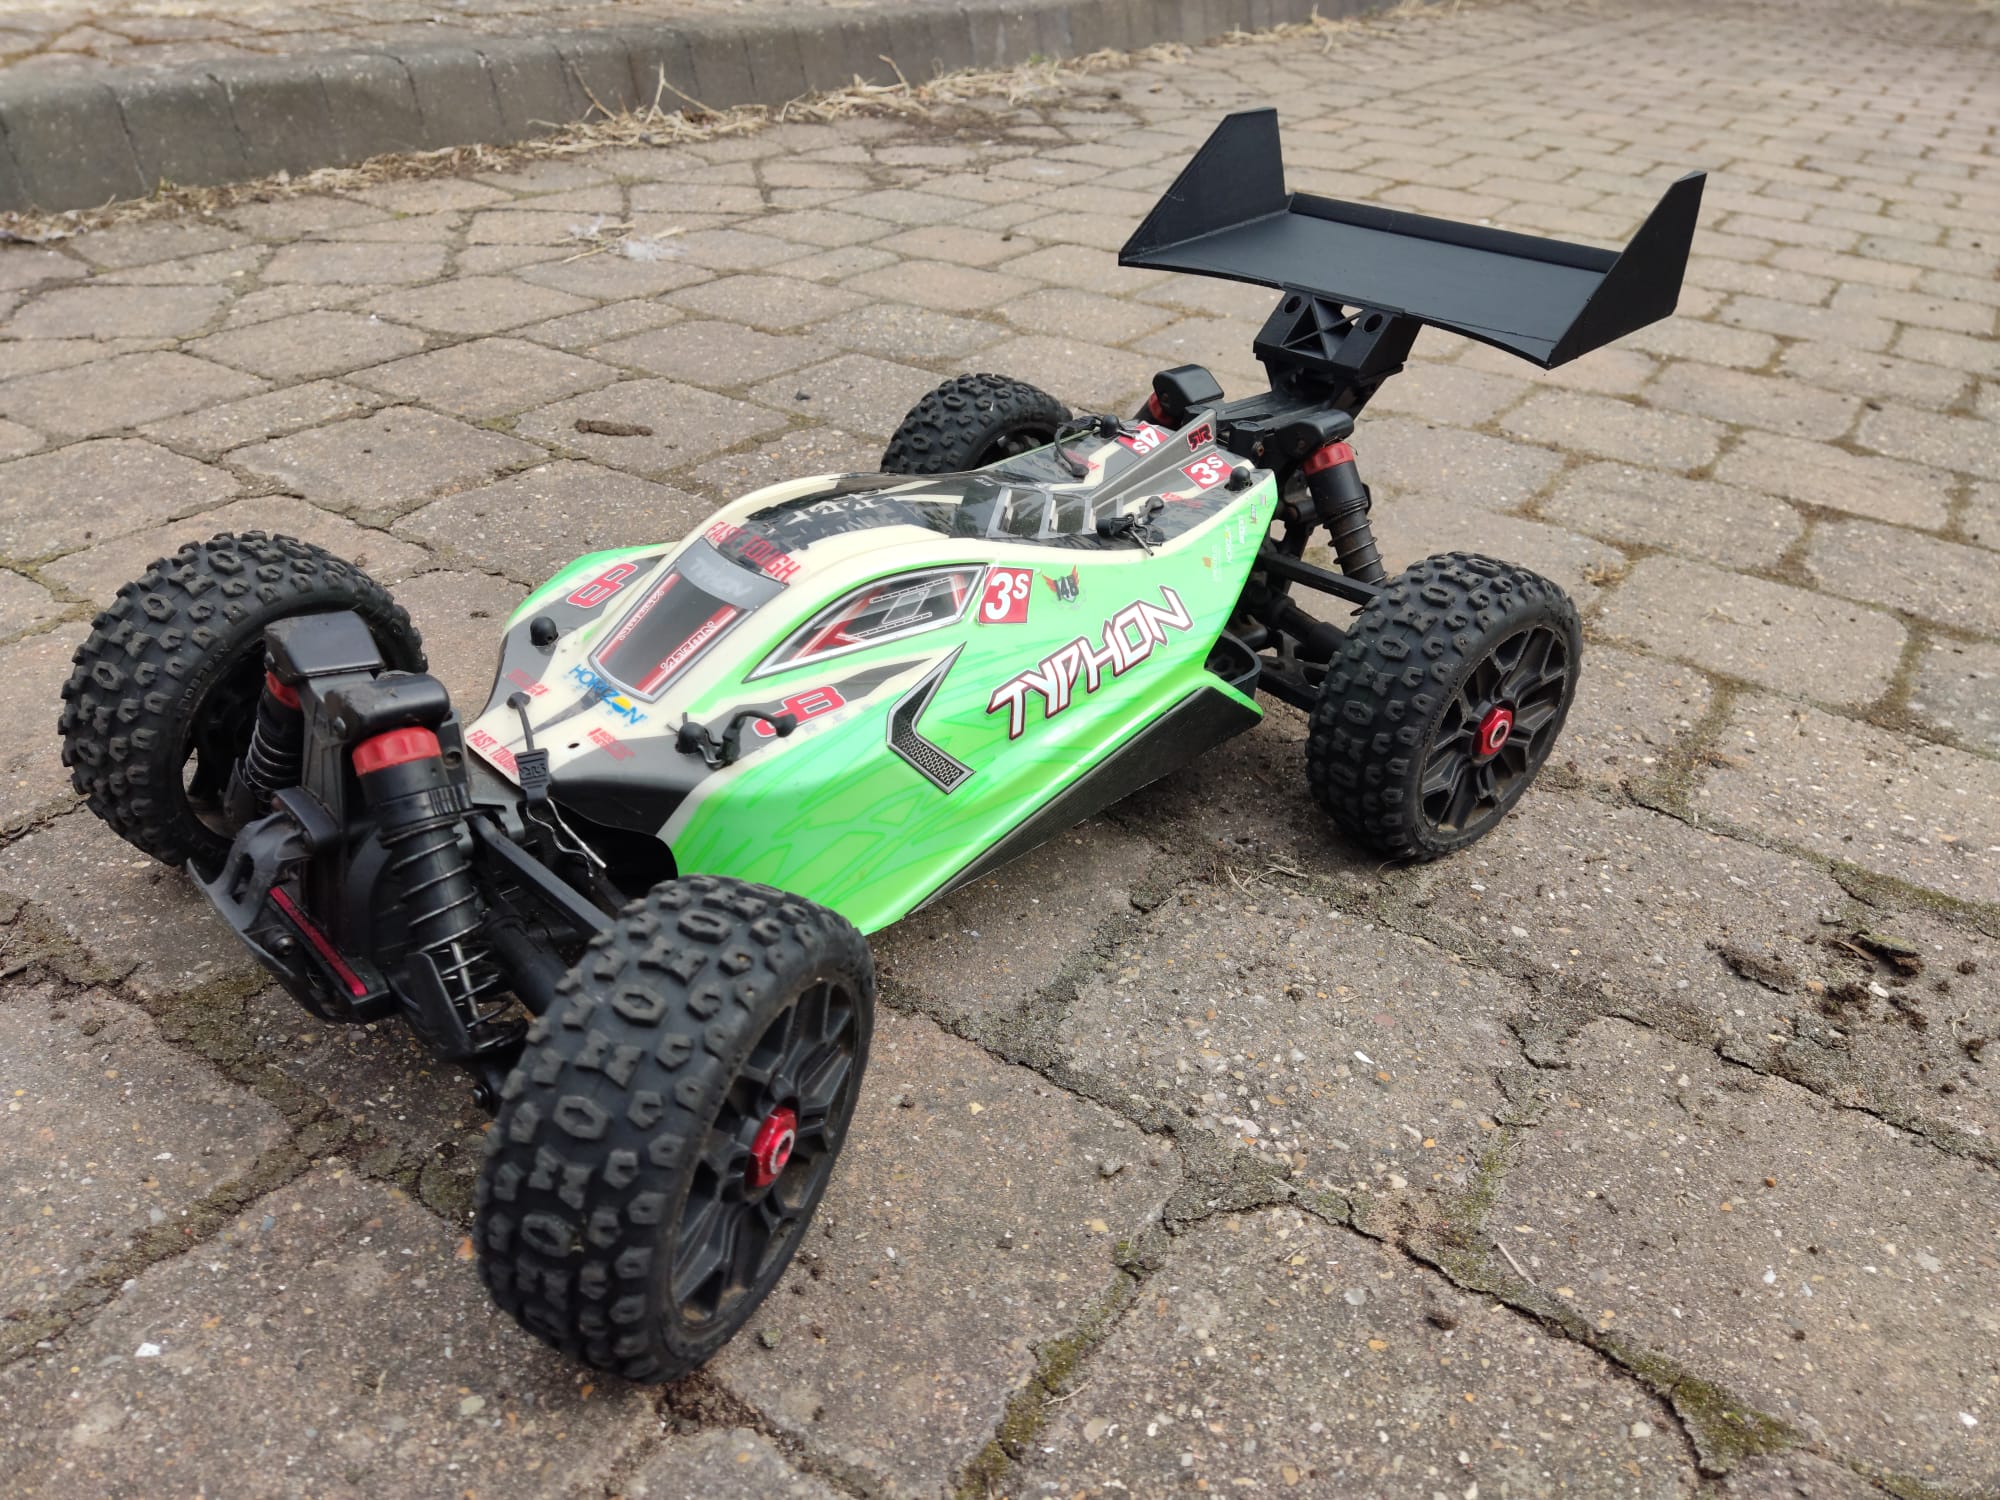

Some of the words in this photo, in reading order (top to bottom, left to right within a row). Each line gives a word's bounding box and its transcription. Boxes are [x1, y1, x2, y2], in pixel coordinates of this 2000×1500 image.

[1190, 456, 1224, 484] 3S
[984, 571, 1030, 621] 3S
[986, 584, 1194, 741] TYPHON
